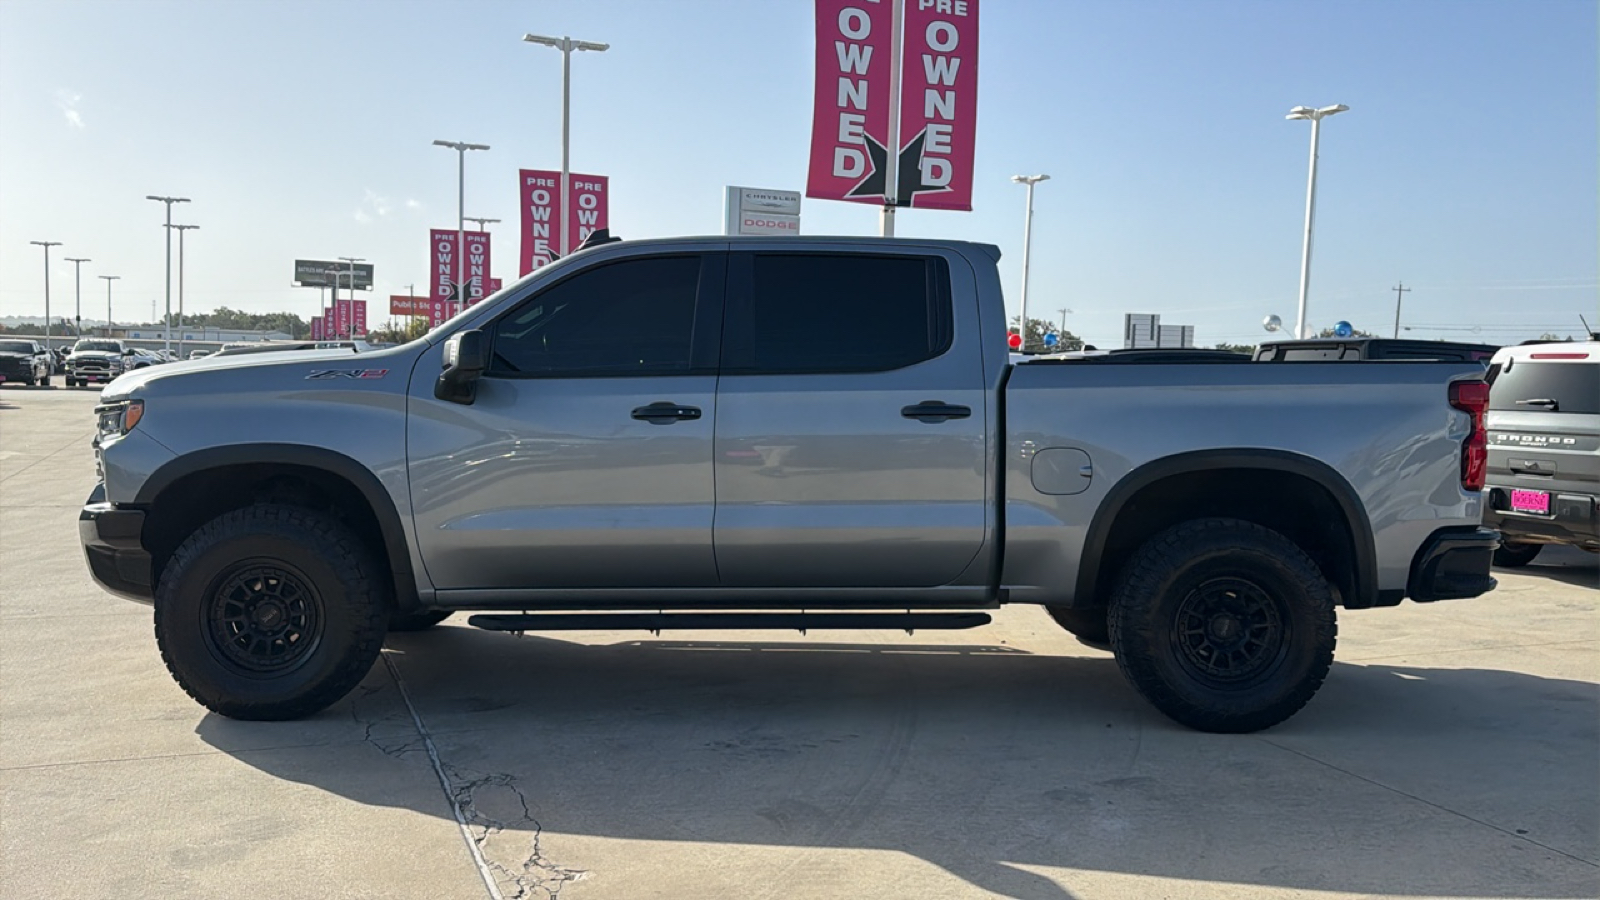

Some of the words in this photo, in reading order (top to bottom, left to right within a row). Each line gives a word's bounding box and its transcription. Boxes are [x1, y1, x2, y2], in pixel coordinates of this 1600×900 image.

[918, 0, 968, 17] PRE
[831, 7, 874, 179] OWNED
[920, 20, 961, 187] OWNED
[526, 177, 555, 187] PRE
[574, 181, 602, 191] PRE
[745, 193, 797, 201] CHRYSLER
[530, 189, 551, 270] OWNED
[577, 193, 599, 241] OWN
[744, 219, 797, 230] DODGE
[438, 242, 452, 296] OWNED
[470, 244, 484, 297] OWNED
[1497, 434, 1576, 445] BRONCO
